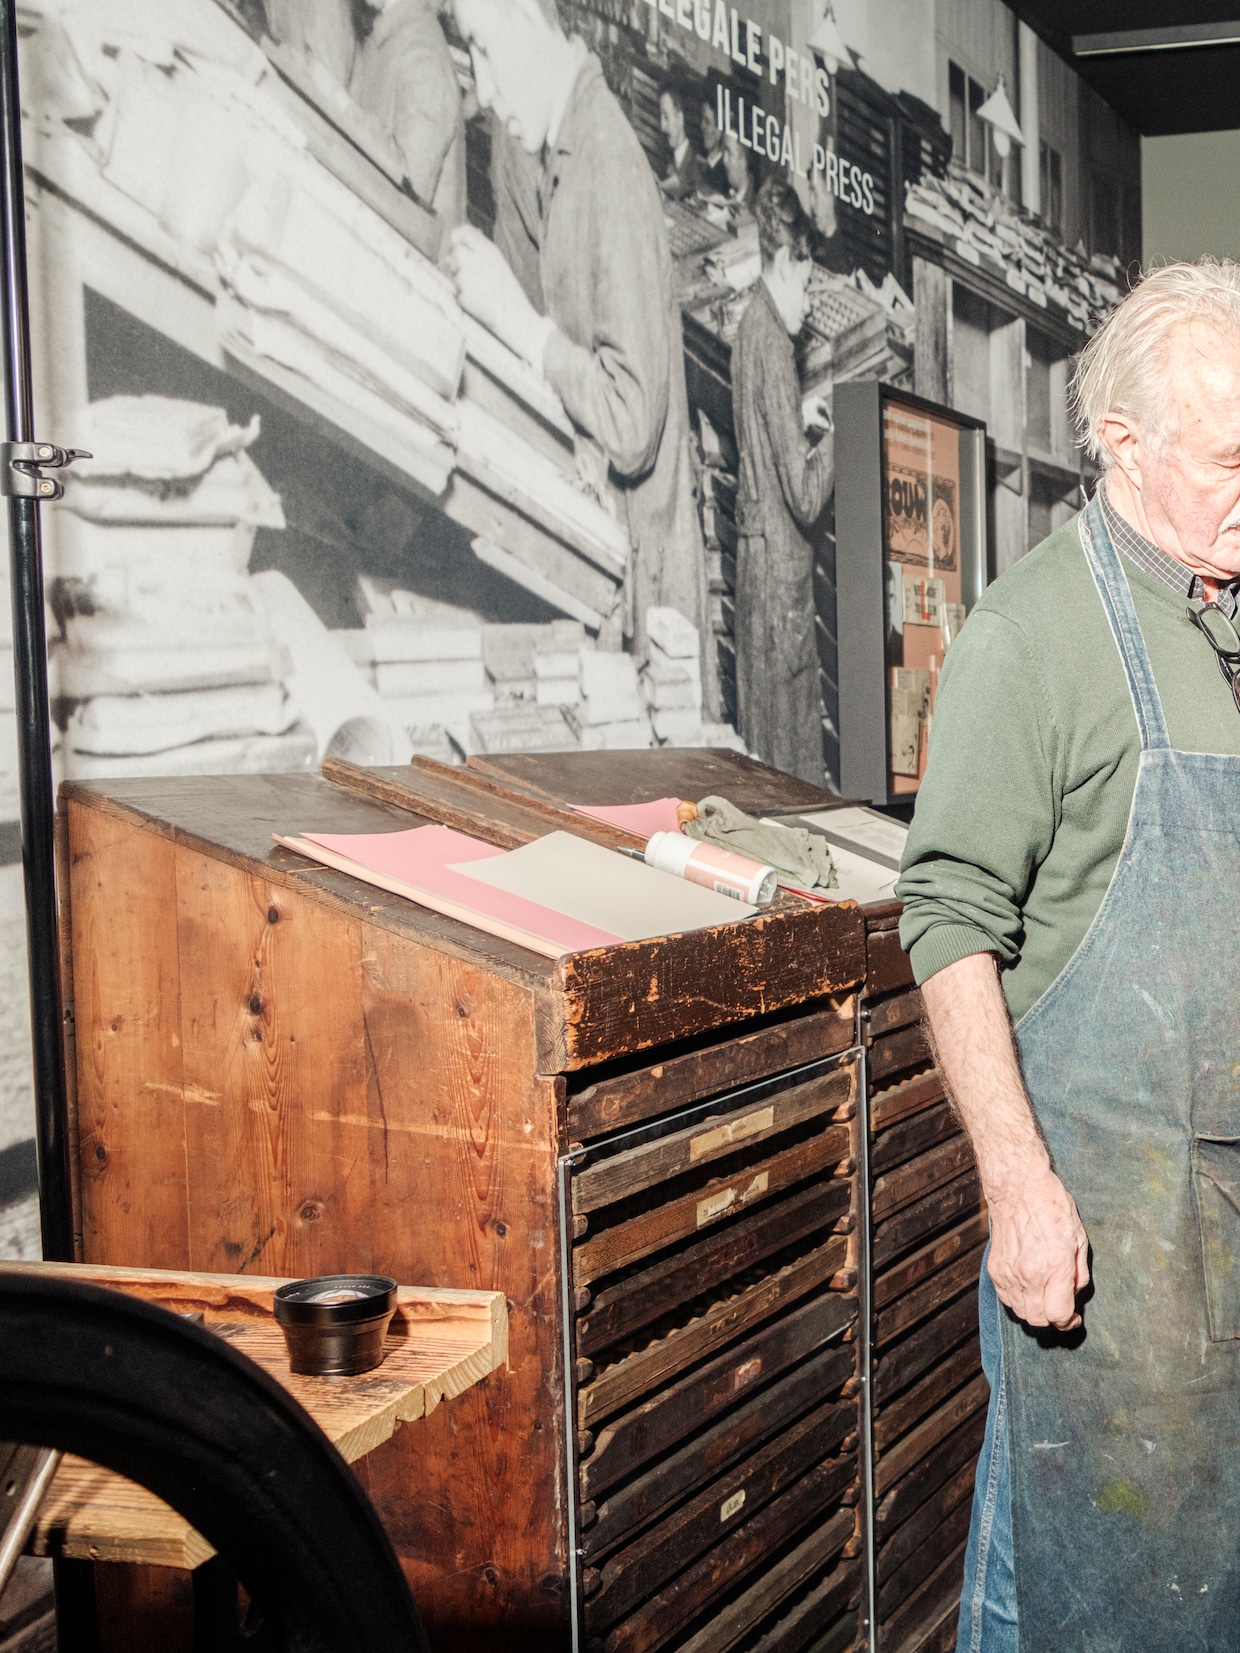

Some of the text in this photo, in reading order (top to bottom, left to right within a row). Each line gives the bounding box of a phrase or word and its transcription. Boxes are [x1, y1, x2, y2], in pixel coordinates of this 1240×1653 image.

[640, 0, 830, 118] EGALE PERS
[717, 83, 874, 215] ILLEGAL PRESS
